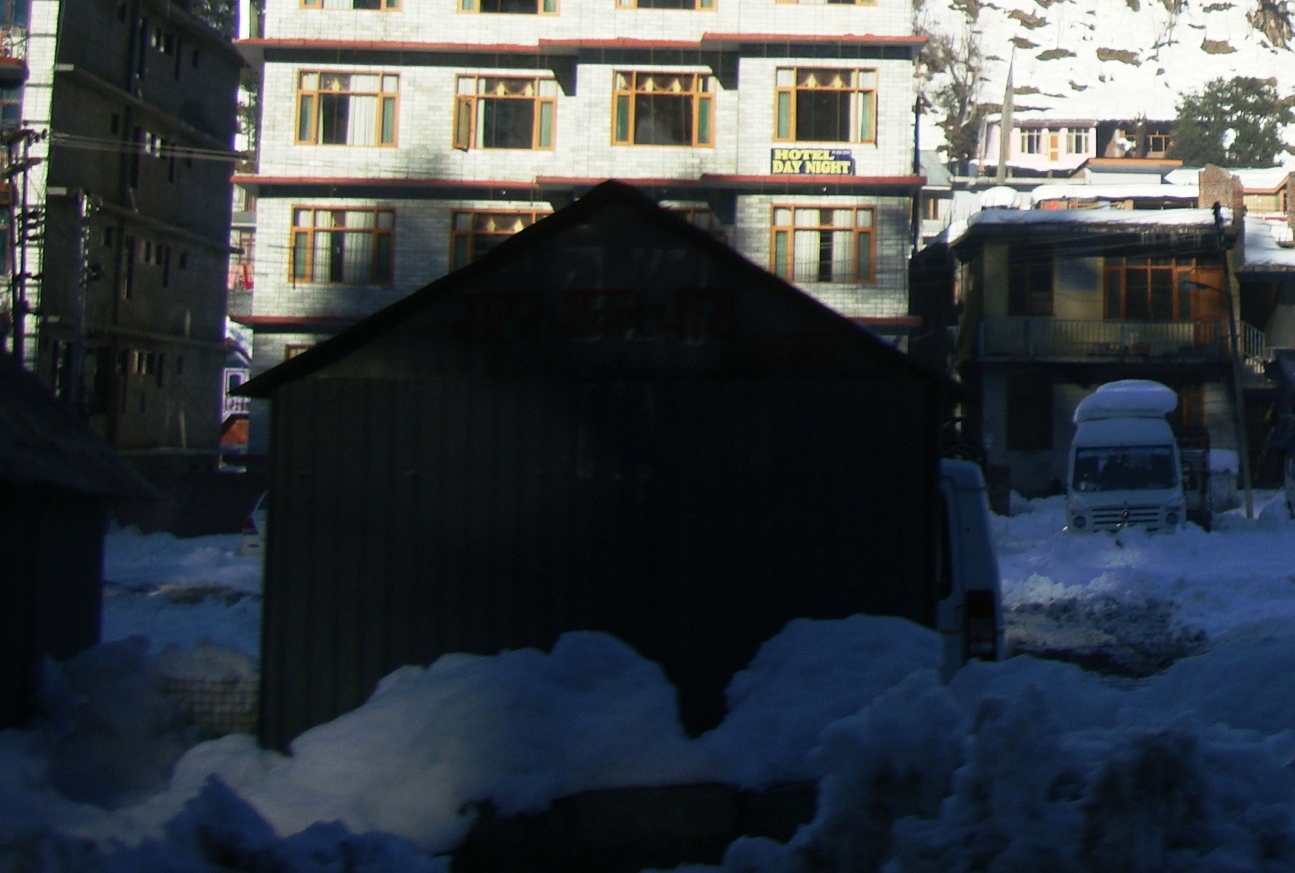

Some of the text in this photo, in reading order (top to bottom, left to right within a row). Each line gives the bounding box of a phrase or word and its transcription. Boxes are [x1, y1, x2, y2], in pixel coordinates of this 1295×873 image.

[774, 149, 835, 160] HOTEL
[772, 160, 851, 174] DAY NIGHT
